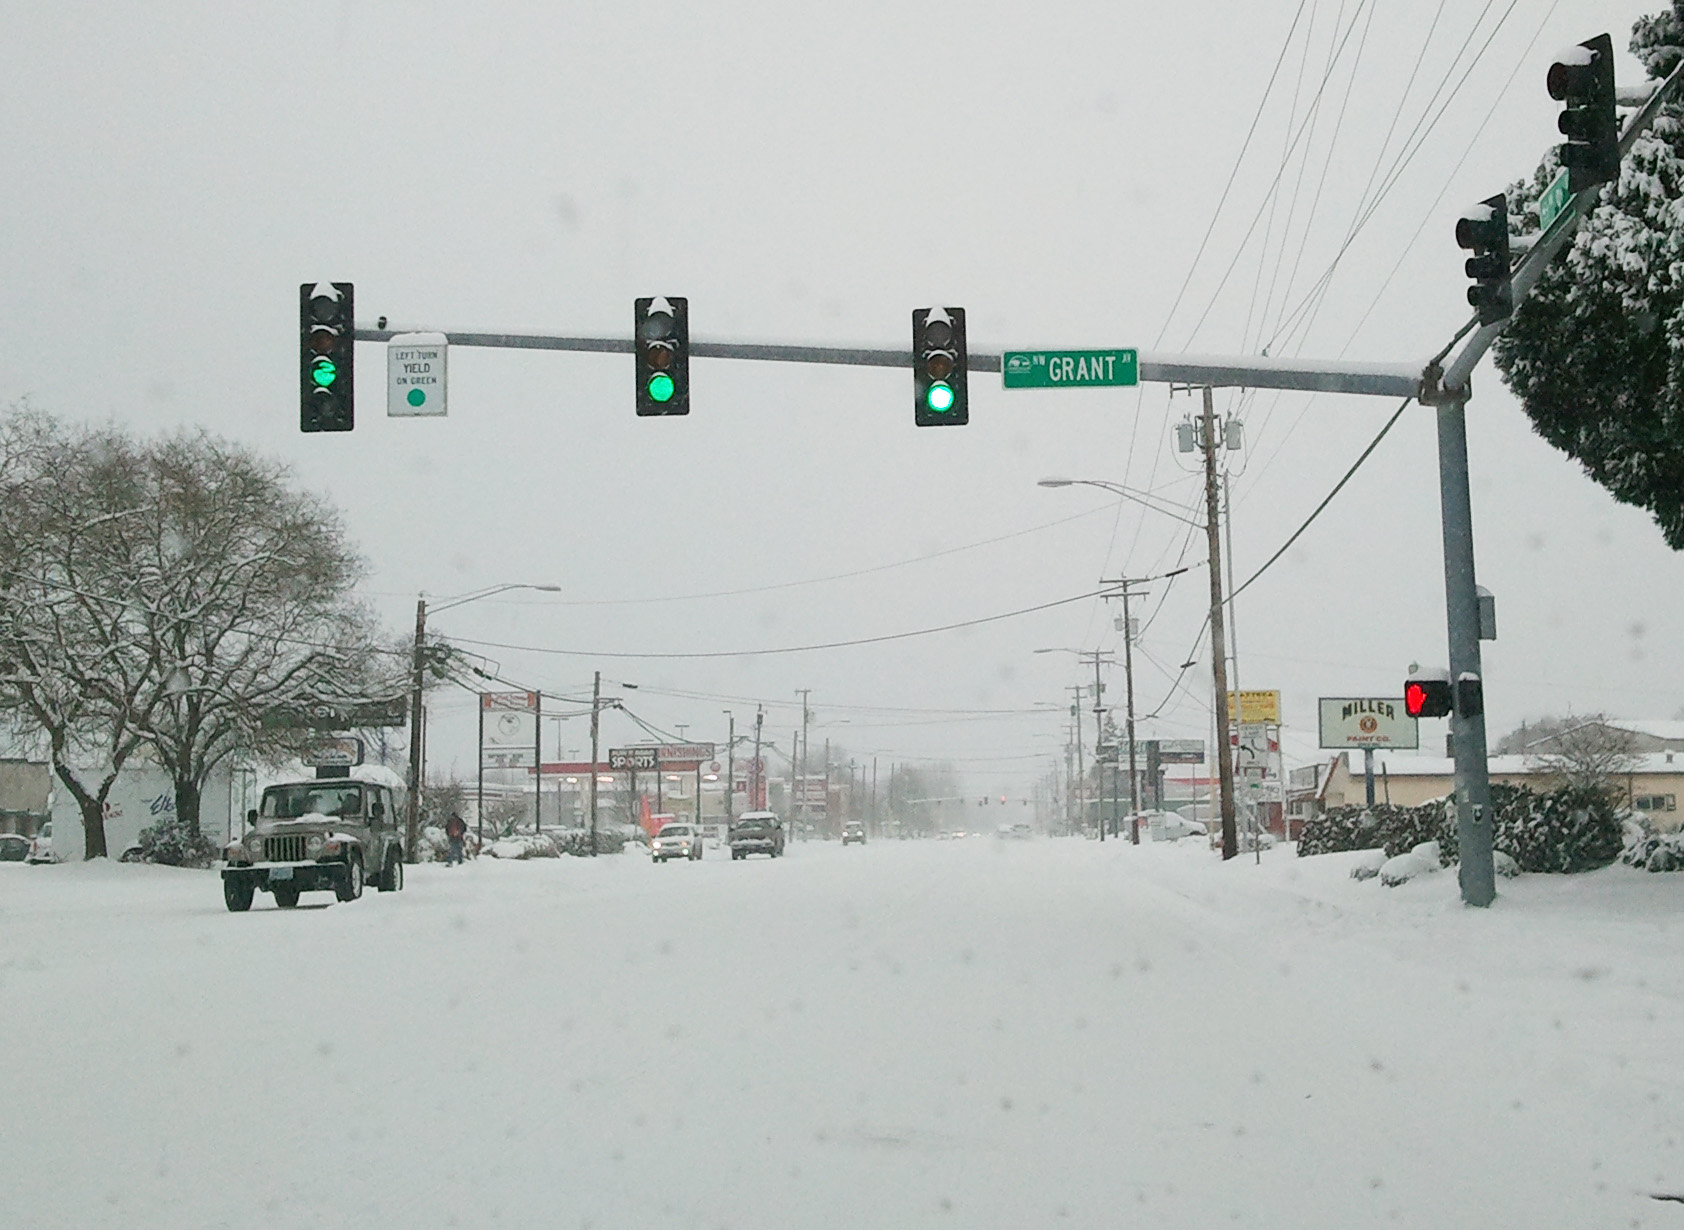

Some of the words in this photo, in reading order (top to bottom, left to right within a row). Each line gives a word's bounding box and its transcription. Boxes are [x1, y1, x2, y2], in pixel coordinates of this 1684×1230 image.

[395, 352, 414, 360] LEFT
[417, 352, 438, 360] TURN
[403, 363, 431, 373] YIELD
[1049, 356, 1116, 381] GRANT
[396, 377, 408, 385] ON
[410, 377, 437, 385] GREEN
[1342, 700, 1395, 721] MILLER
[611, 756, 655, 769] SPORTS
